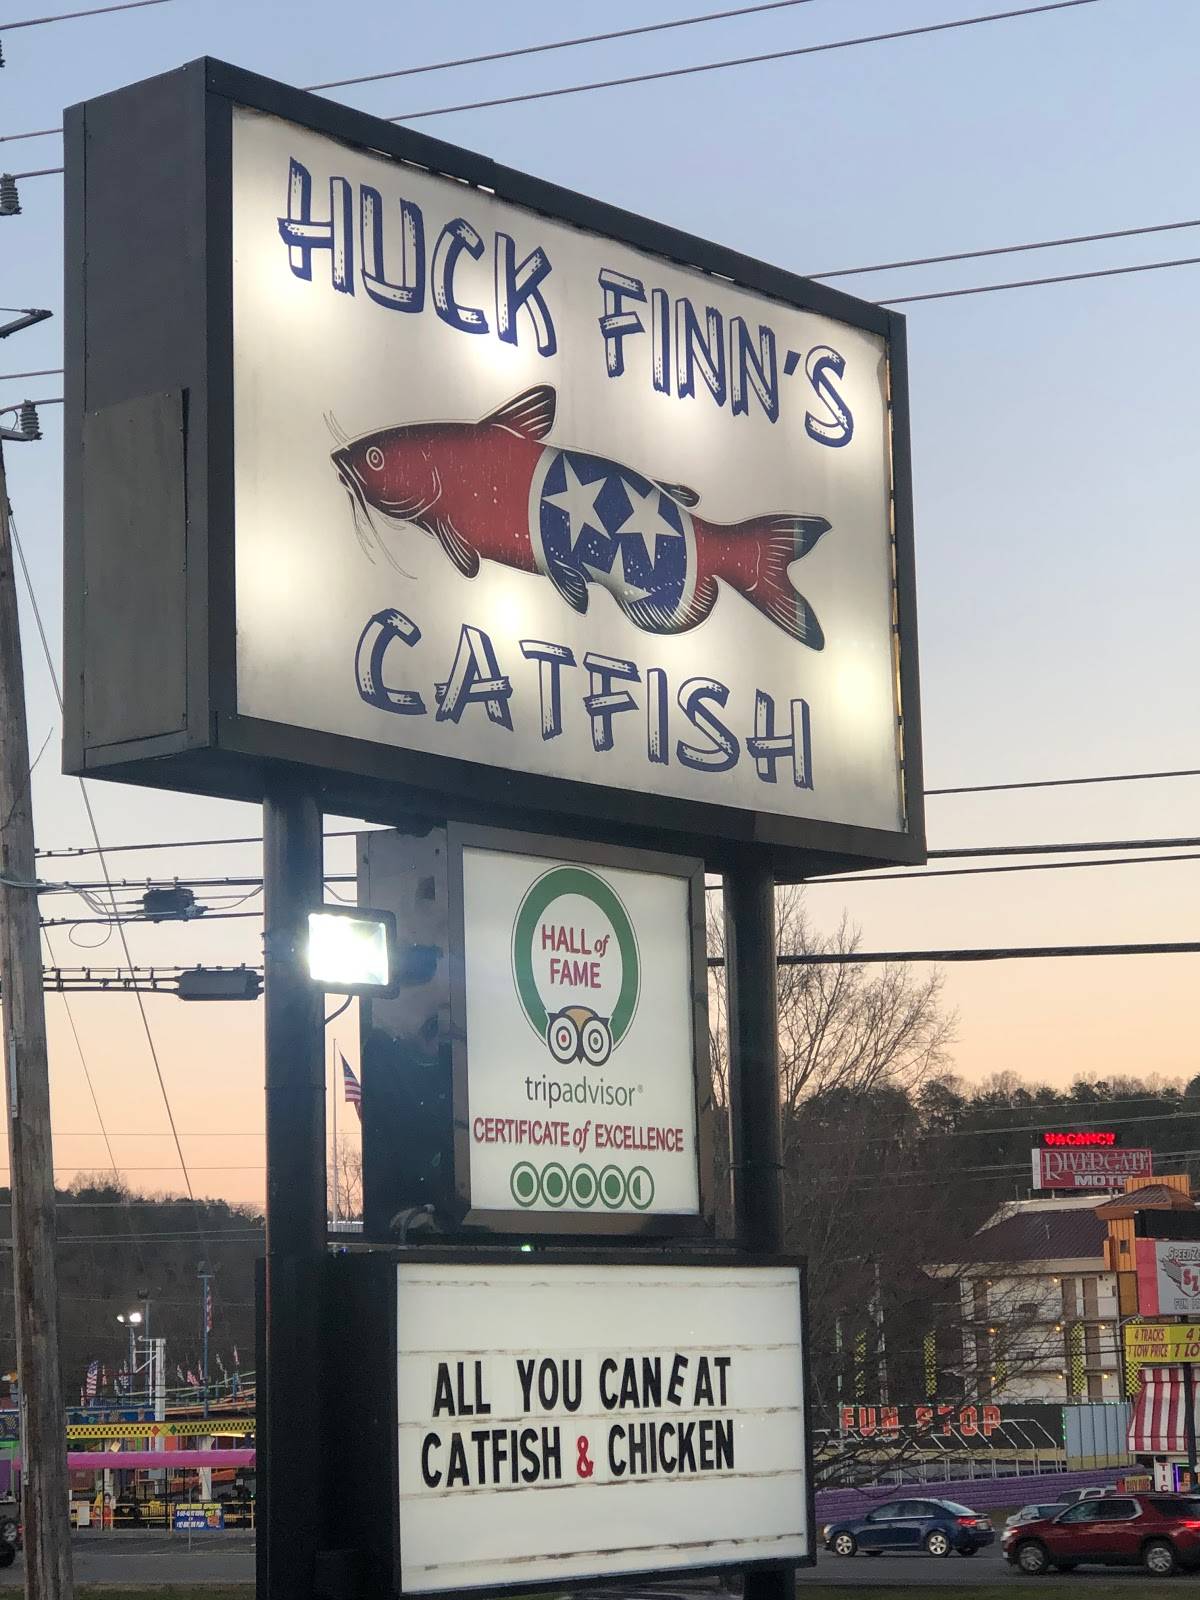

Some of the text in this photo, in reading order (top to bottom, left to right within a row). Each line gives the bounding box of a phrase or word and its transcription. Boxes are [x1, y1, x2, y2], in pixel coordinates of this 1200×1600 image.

[277, 156, 854, 448] HUCK FINN'S
[354, 607, 814, 791] CATFISH
[541, 924, 610, 958] HALL of
[549, 958, 602, 989] FAME
[473, 1117, 685, 1153] CERTIFICATE of EXCELLENCE
[1043, 1132, 1117, 1146] VACANCY
[1074, 1175, 1126, 1186] MOTE
[1168, 1246, 1200, 1262] SPEEDZ
[1141, 1328, 1165, 1342] TRACKS
[1184, 1343, 1200, 1357] LO
[432, 1360, 492, 1418] ALL
[516, 1357, 583, 1413] YOU
[840, 1405, 1001, 1440] FUN STOP
[420, 1419, 735, 1489] CATFISH & CHICKEN
